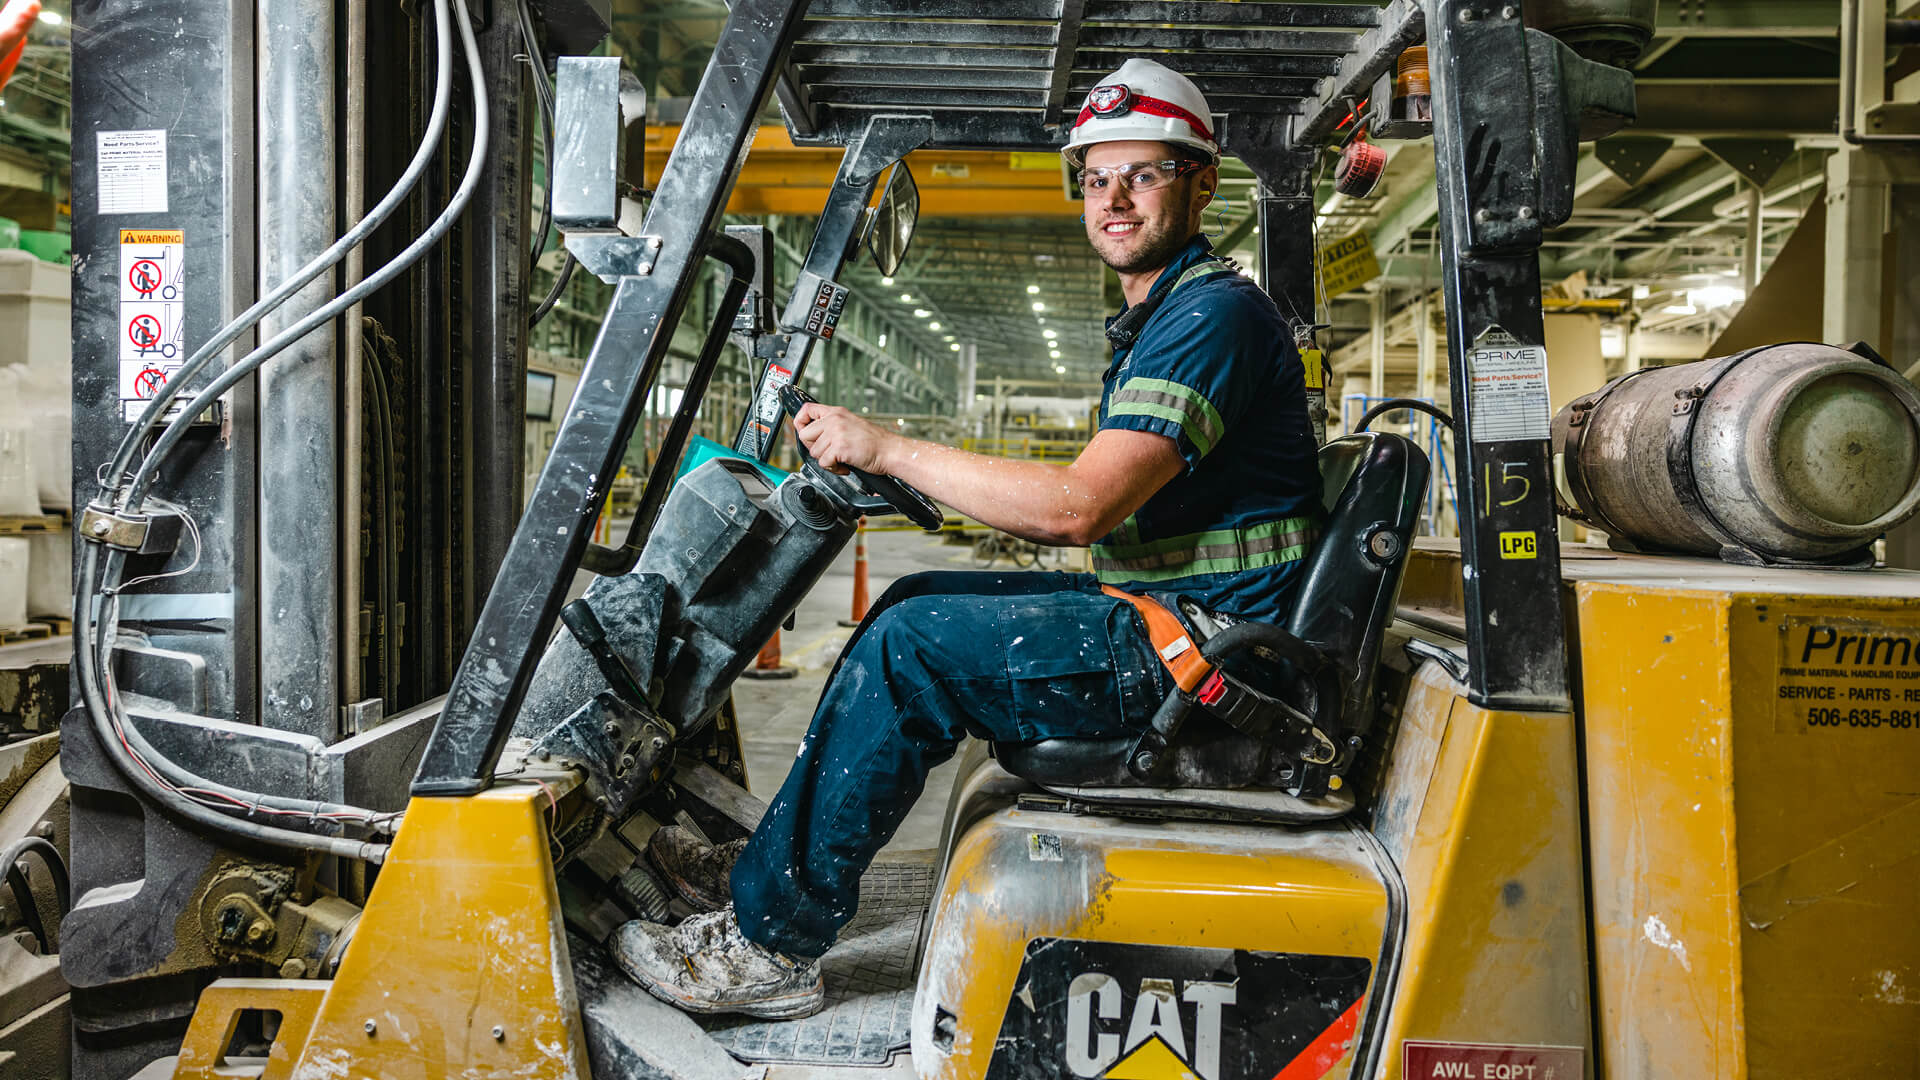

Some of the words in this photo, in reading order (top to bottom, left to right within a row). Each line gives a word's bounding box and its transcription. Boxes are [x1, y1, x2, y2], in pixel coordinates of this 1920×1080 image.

[137, 234, 181, 243] WARNING
[1475, 349, 1536, 362] PRIME
[1485, 462, 1530, 517] 15
[1502, 537, 1535, 554] LPG
[1780, 667, 1806, 677] PRIME
[1808, 668, 1848, 678] MATERIAL
[1851, 669, 1894, 679] HANDLING
[1779, 686, 1836, 700] SERVICE
[1849, 688, 1891, 701] PARTS
[1065, 972, 1237, 1080] CAT
[1432, 1061, 1475, 1079] AWL
[1483, 1063, 1536, 1080] EQPT
